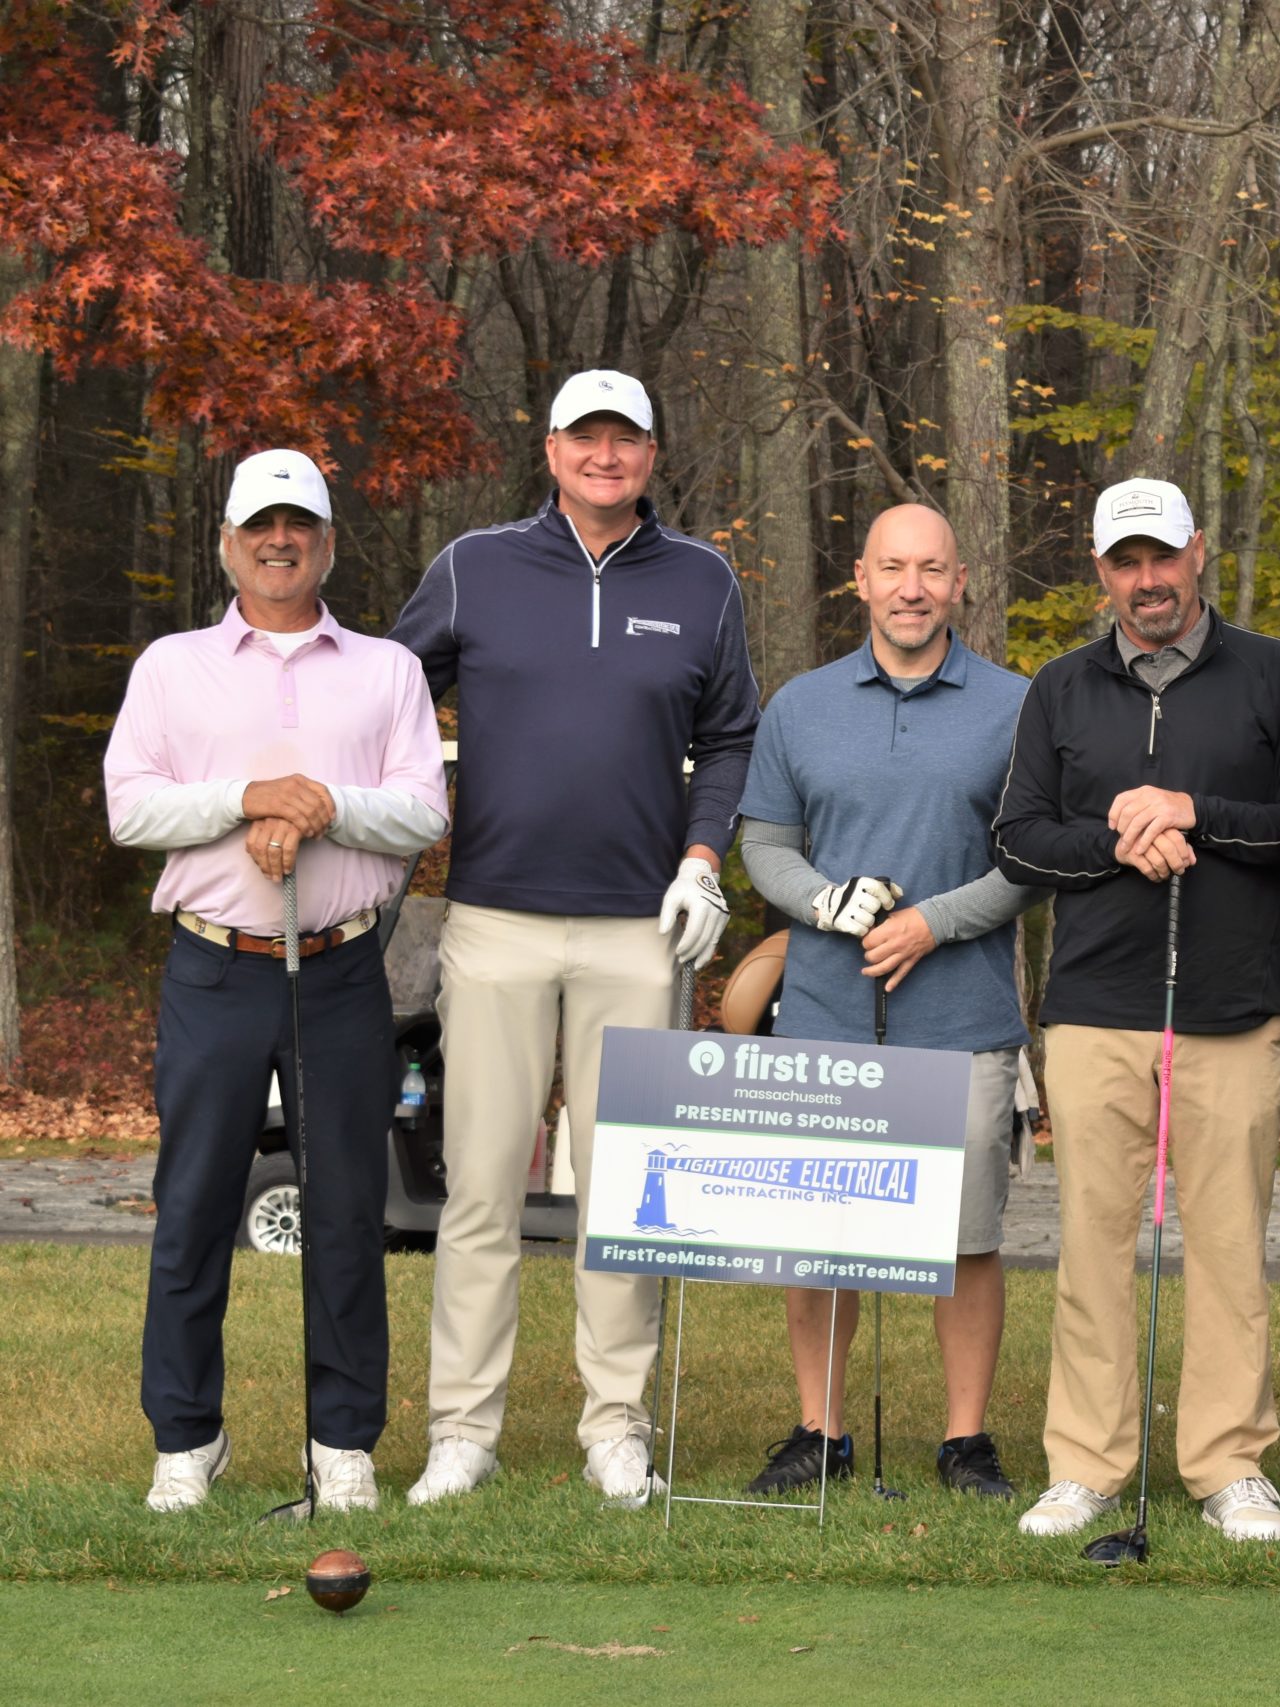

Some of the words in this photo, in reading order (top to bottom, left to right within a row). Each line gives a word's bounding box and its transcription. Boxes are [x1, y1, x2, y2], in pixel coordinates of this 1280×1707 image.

[734, 1042, 809, 1084] first
[817, 1052, 885, 1089] tee
[734, 1086, 843, 1105] massachusetts
[675, 1104, 793, 1127] PRESENTING
[797, 1113, 889, 1134] SPONSOR
[674, 1158, 791, 1184] LIGHTHOUSE
[799, 1159, 909, 1200] ELECTRICAL
[701, 1183, 815, 1202] CONTRACTING
[821, 1190, 852, 1205] INC.
[602, 1244, 764, 1274] FirstTeeMass.org
[794, 1259, 938, 1284] @FirstTeeMass
